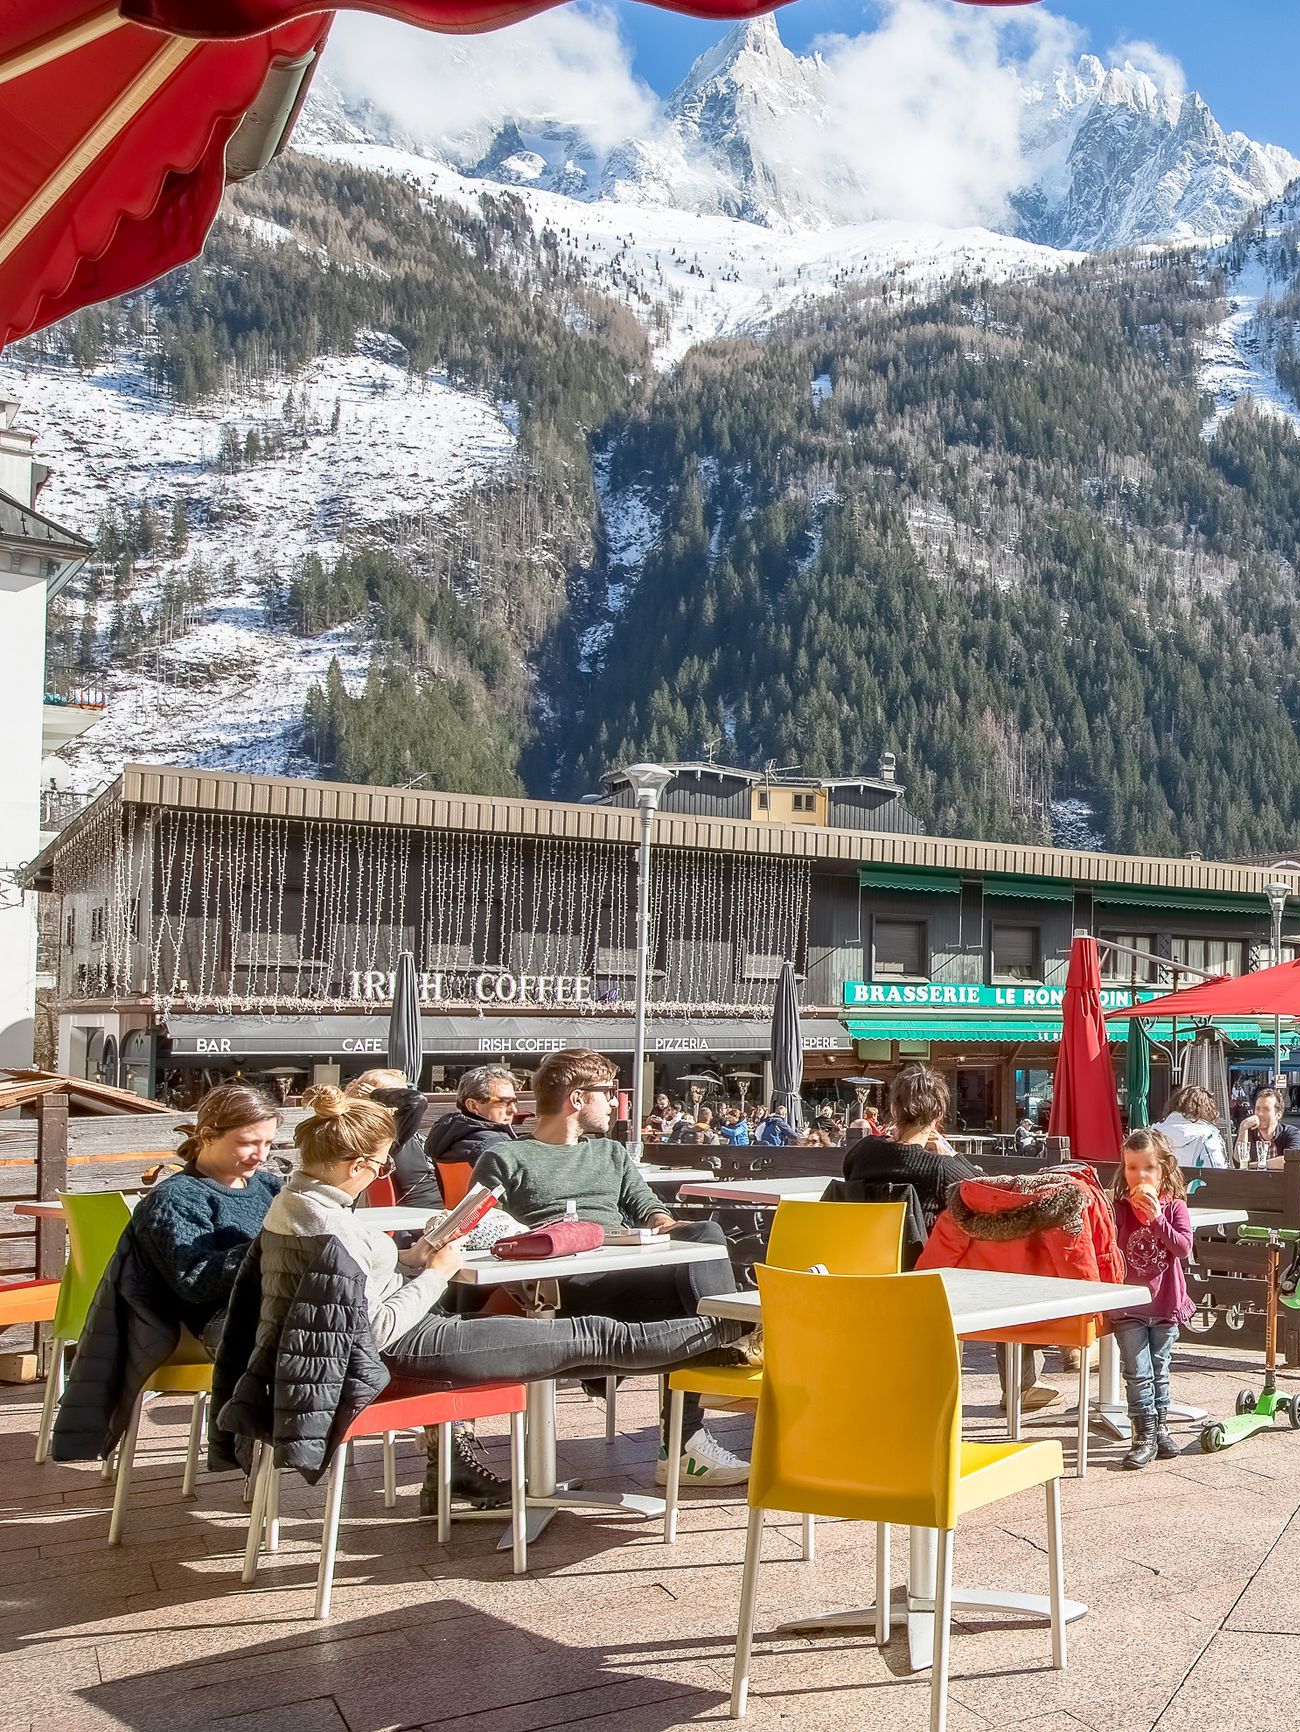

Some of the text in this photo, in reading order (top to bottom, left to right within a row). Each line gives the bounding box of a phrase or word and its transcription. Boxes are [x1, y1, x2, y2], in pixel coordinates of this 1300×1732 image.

[350, 970, 591, 1000] IRIH COFFEE
[854, 985, 980, 1003] BRASSERIE
[995, 987, 1016, 1005] LE
[1023, 989, 1066, 1005] RON
[196, 1038, 231, 1052] BAR
[342, 1038, 383, 1052] CAFE
[478, 1038, 567, 1050] IRISH COFFEE
[655, 1037, 708, 1050] PIZZERIA
[801, 1037, 839, 1049] EPERIE
